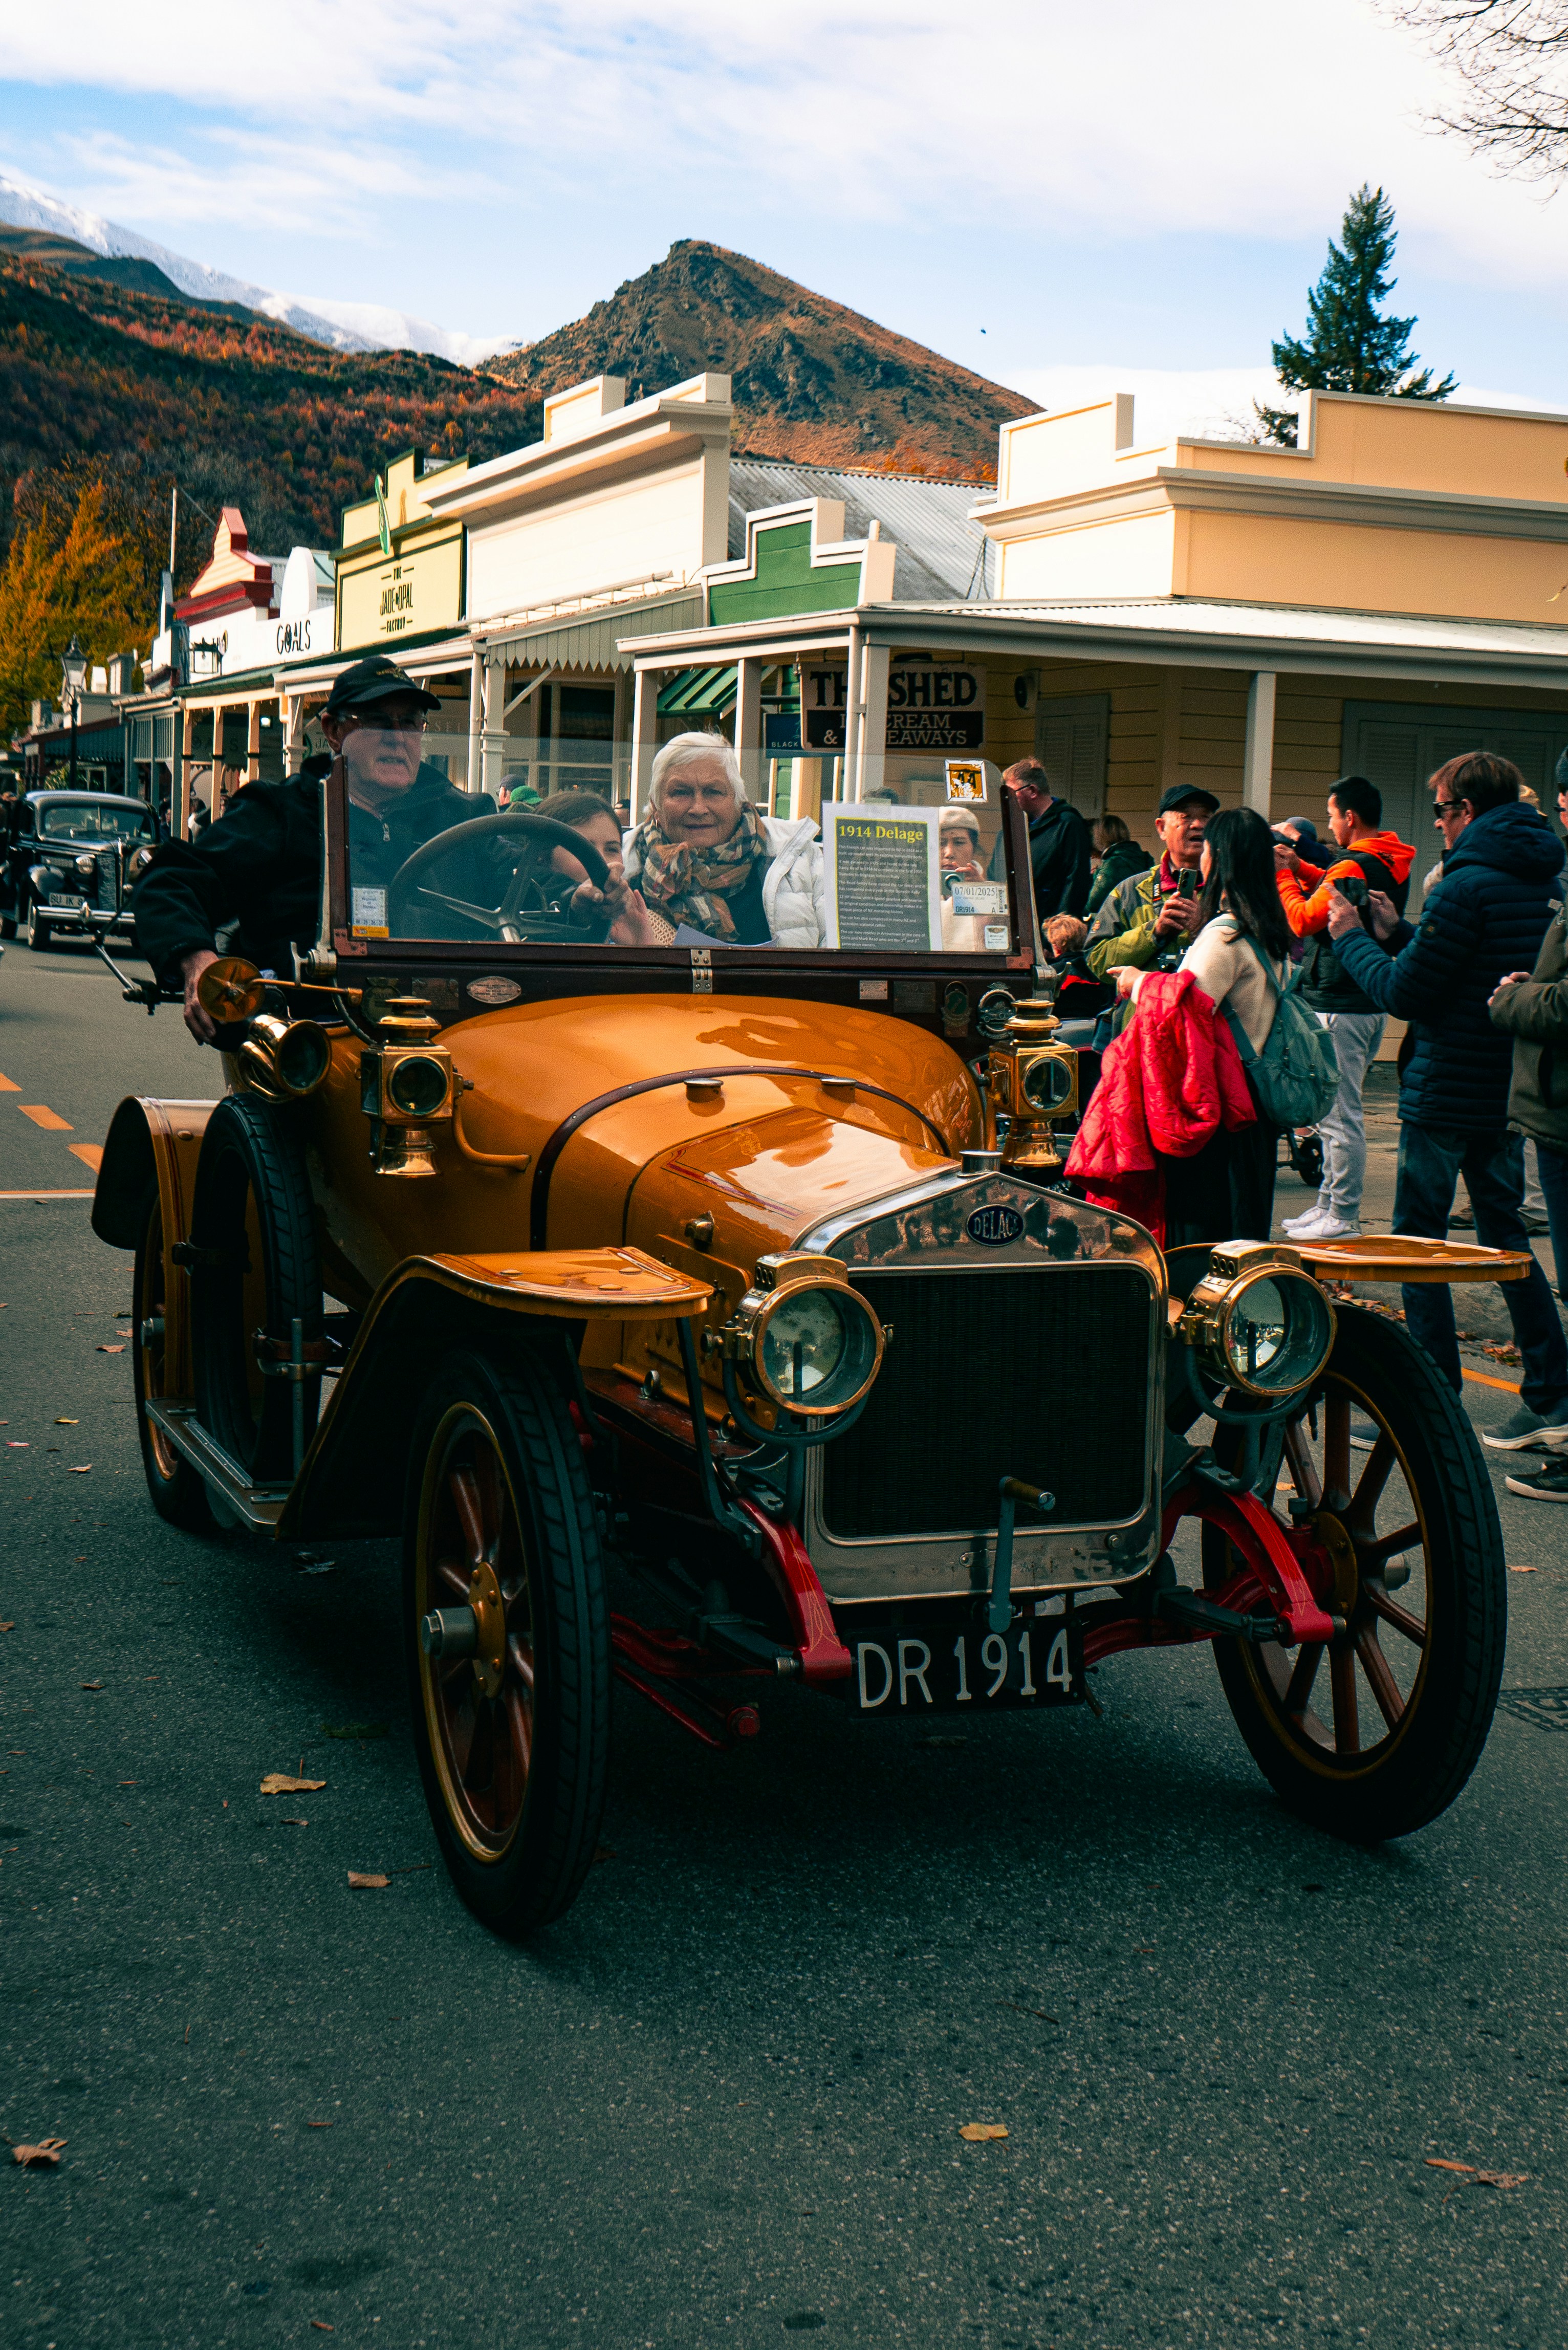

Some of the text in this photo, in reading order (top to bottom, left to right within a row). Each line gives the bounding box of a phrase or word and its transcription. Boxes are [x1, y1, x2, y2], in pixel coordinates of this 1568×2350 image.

[380, 588, 395, 616] JADE
[398, 582, 413, 611] OPAL
[277, 620, 311, 655] GOALS
[386, 616, 405, 633] FACTORY
[810, 671, 977, 707] TH SHED
[823, 729, 967, 745] & EAWAYS
[839, 825, 923, 843] 1914 Delage
[954, 886, 995, 896] 07/01/2025
[974, 1211, 1019, 1239] DELAGE
[857, 1628, 1073, 1708] DR 1914
